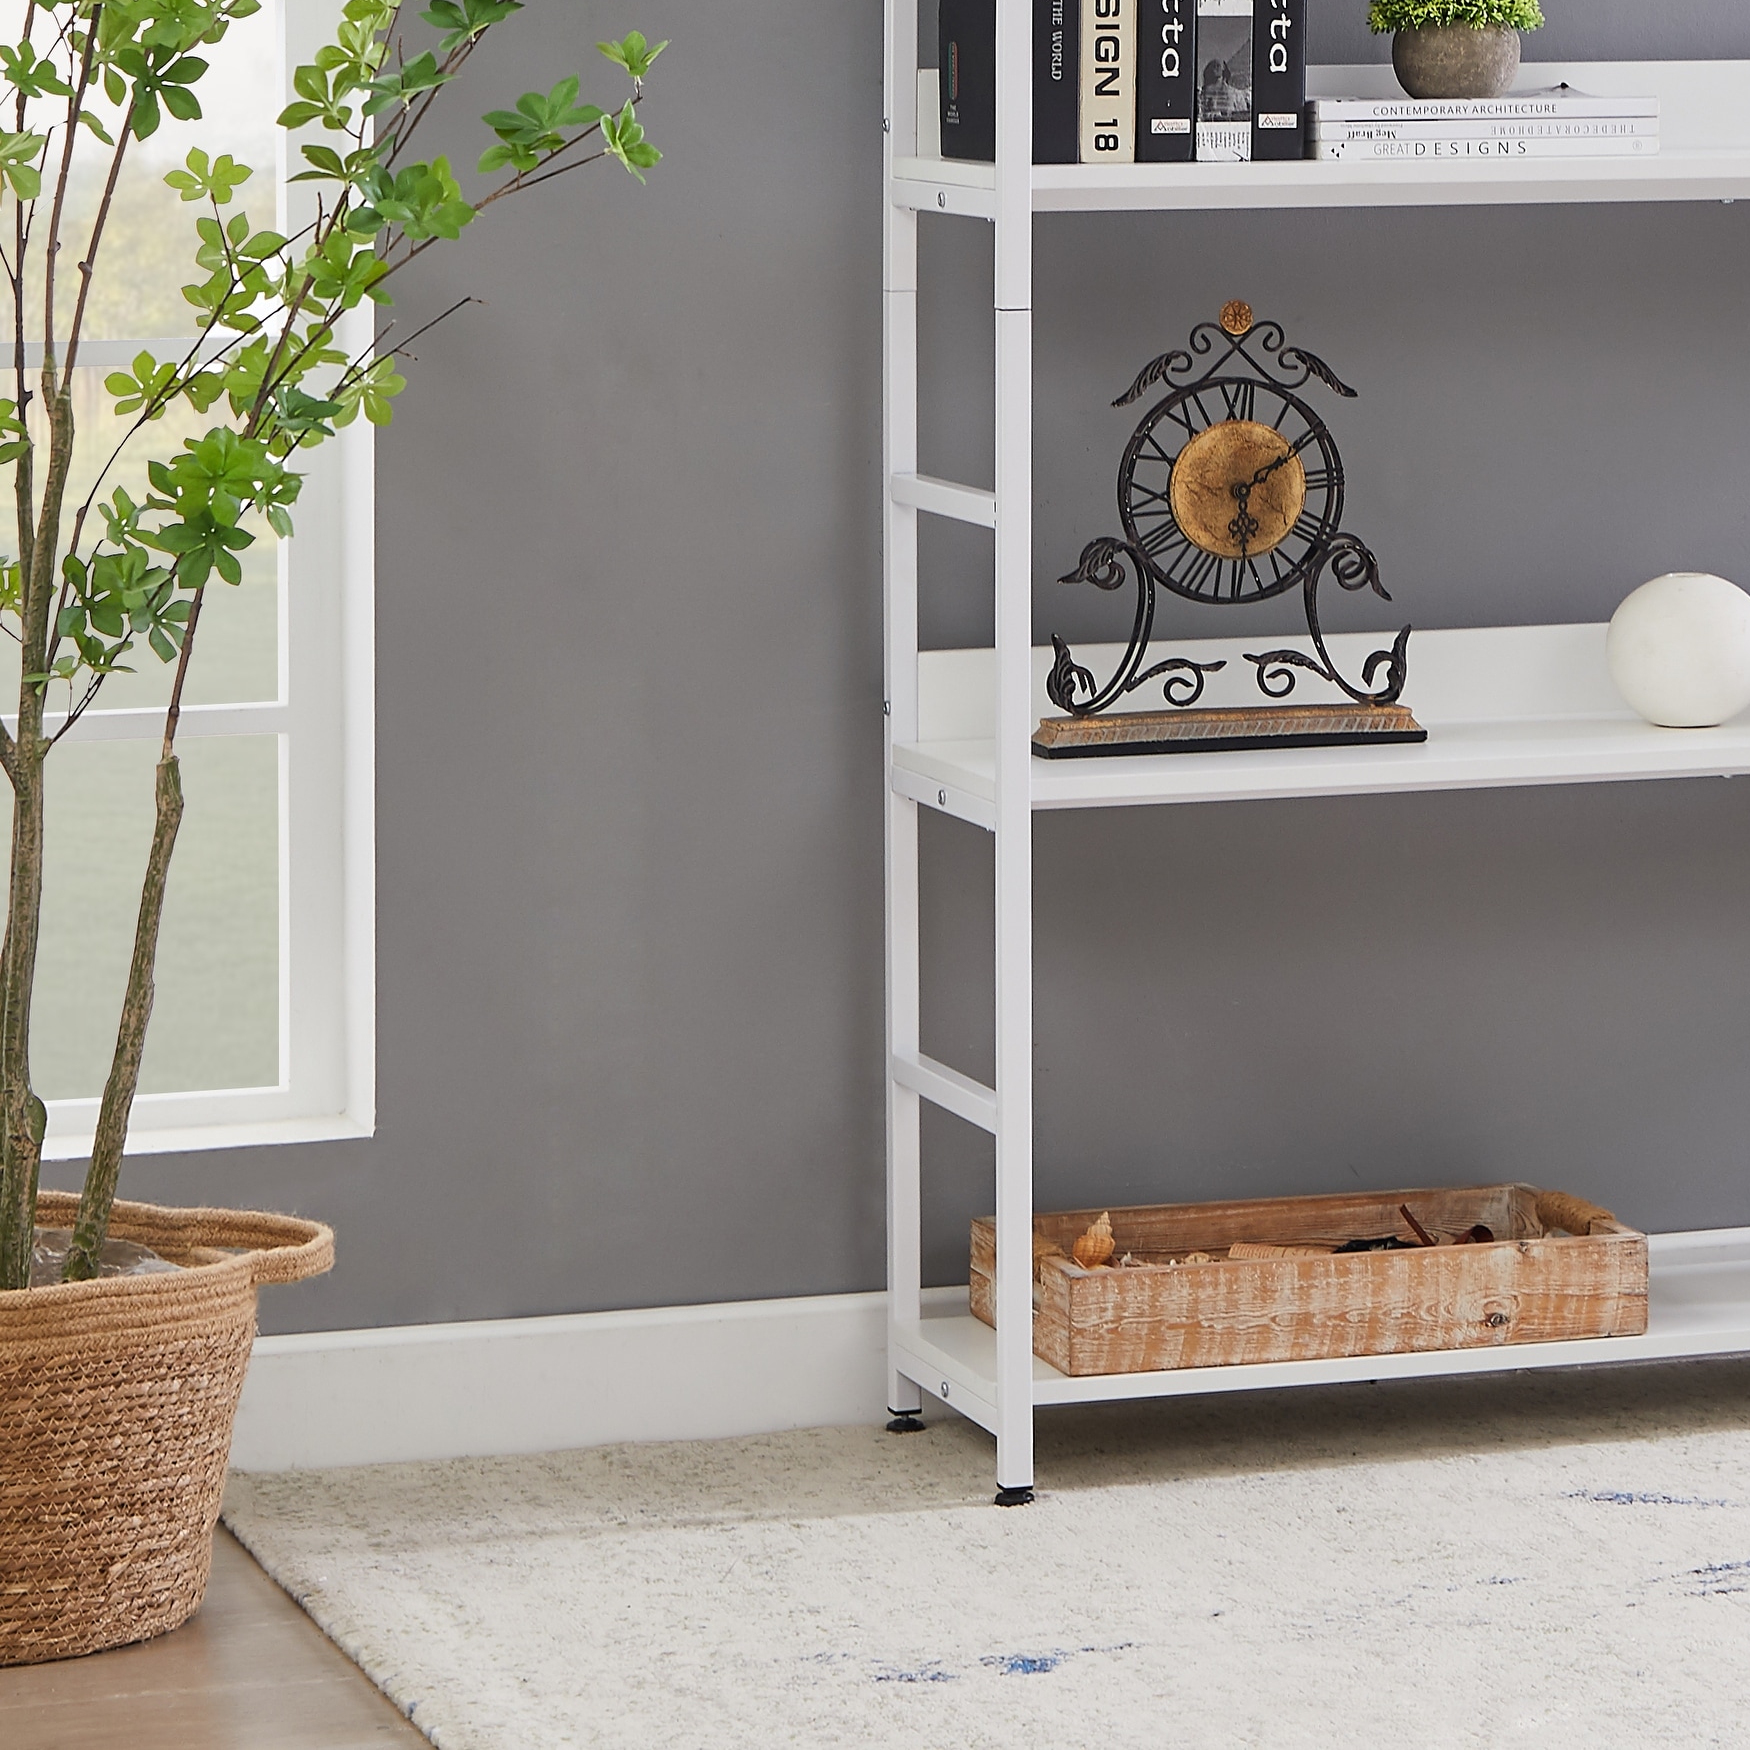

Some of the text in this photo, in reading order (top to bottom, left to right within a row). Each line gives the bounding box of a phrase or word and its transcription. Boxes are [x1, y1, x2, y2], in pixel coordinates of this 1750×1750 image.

[1052, 0, 1063, 26] THE
[1051, 31, 1063, 81] WORLD
[1373, 103, 1557, 116] CONTEMPORARY ARCHITECTURE
[1094, 118, 1119, 152] 18
[1373, 141, 1526, 155] GREAT DESIGNS
